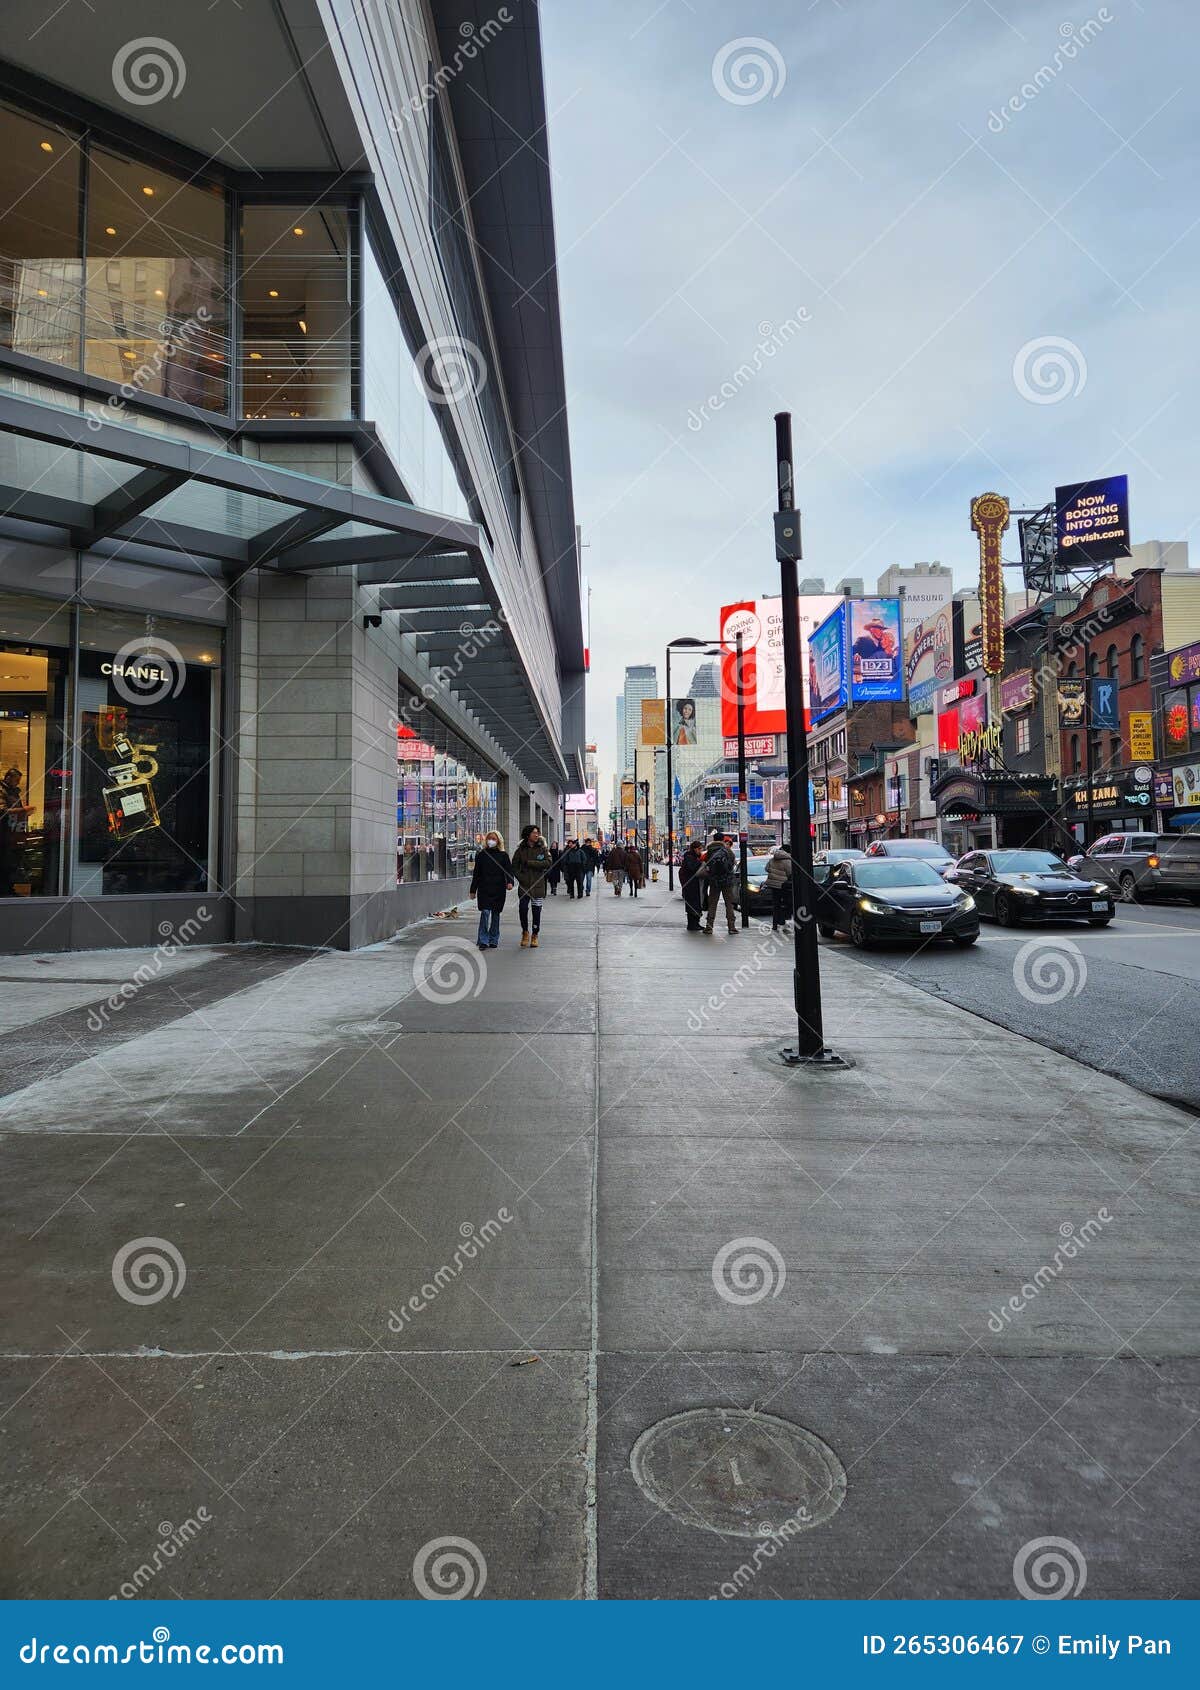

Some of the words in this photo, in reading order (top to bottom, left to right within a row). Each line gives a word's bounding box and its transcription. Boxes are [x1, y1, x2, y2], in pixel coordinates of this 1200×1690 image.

[1077, 494, 1105, 507] NOW
[1065, 504, 1118, 520] BOOKING
[1066, 519, 1093, 531] INTO
[1094, 515, 1119, 527] 2023
[1061, 529, 1124, 547] mirvish.com
[903, 594, 944, 602] SAMSUNG
[726, 617, 754, 635] BOXING
[767, 615, 783, 625] Giv
[731, 626, 752, 639] WEK
[908, 634, 935, 677] BREWERS
[100, 663, 169, 682] CHANEL
[864, 661, 889, 671] 1923
[943, 679, 975, 705] GameStop
[725, 741, 739, 750] JAC
[744, 739, 773, 749] ASTOR'S
[958, 731, 977, 767] Harry
[977, 721, 1001, 755] Potter
[1075, 786, 1118, 803] KHZANA
